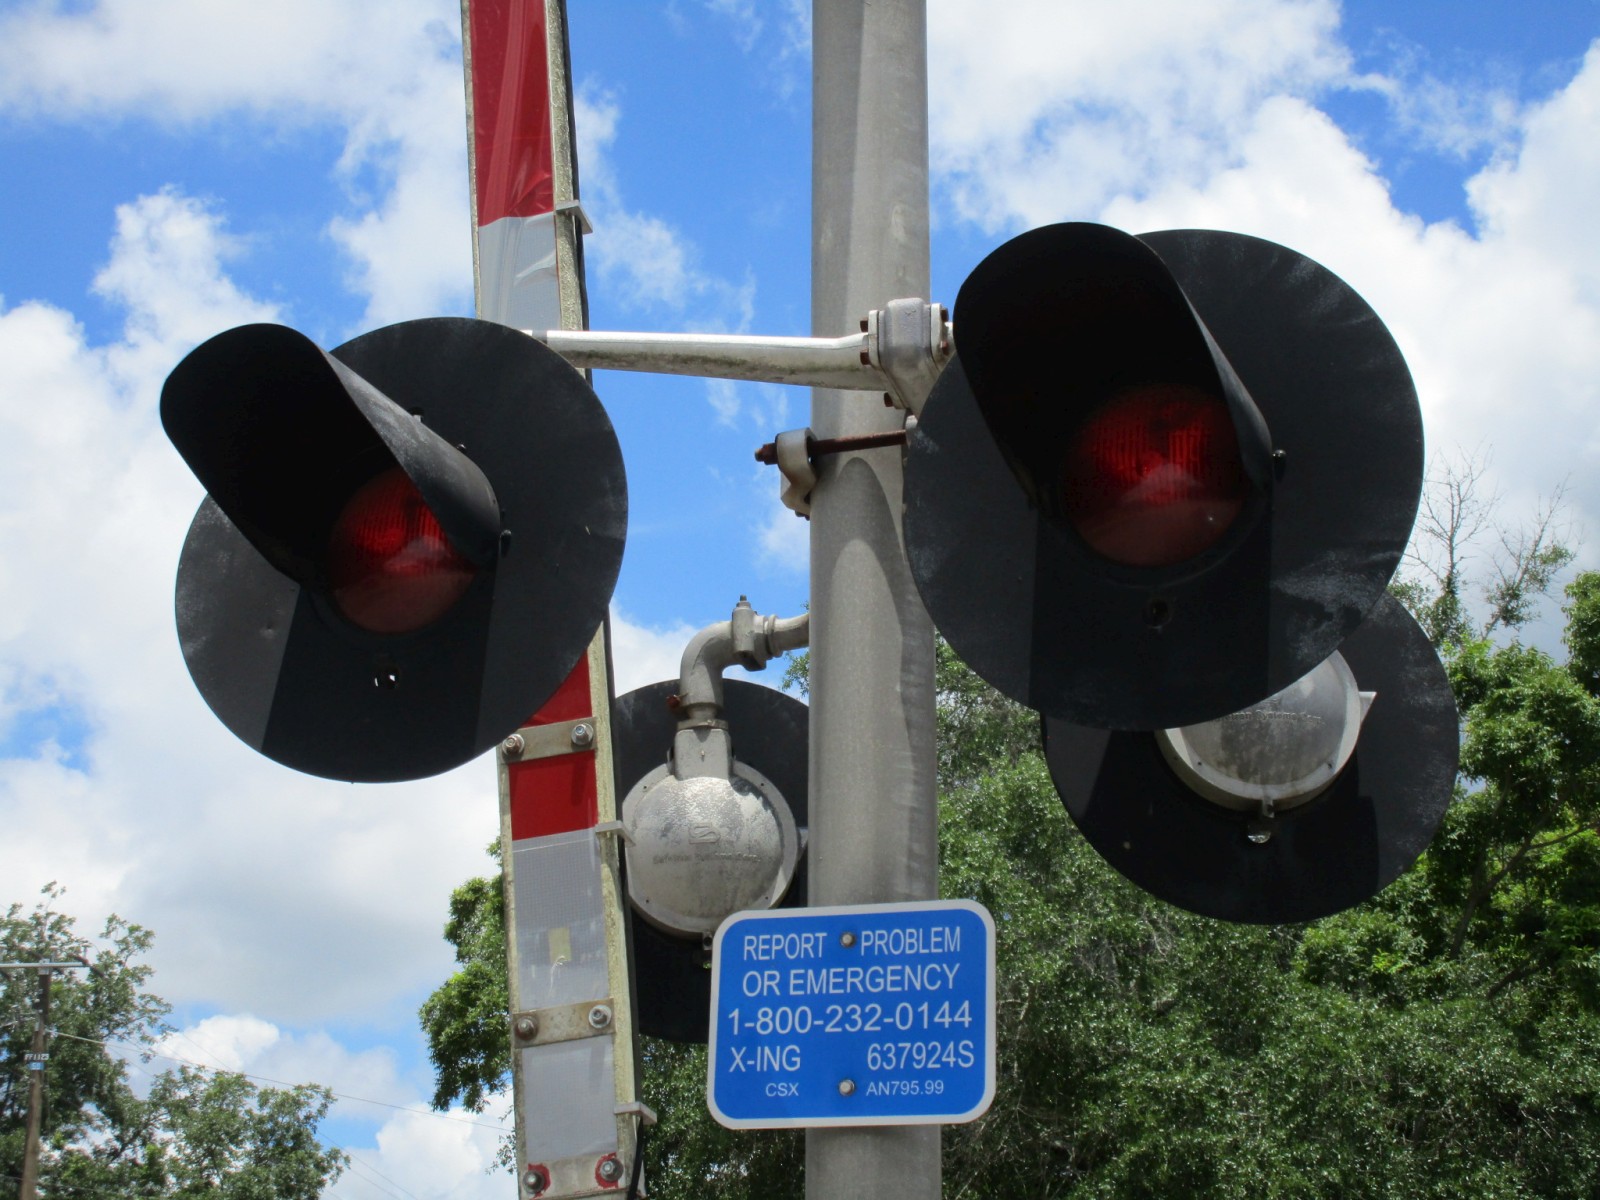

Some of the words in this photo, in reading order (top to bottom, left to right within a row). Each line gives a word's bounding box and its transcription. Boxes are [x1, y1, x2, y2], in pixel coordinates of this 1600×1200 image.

[744, 933, 827, 961] REPORT
[861, 926, 961, 956] PROBLEM
[743, 970, 781, 997] OR
[789, 963, 960, 996] EMERGENCY
[728, 999, 973, 1035] 1-800-232-0144
[729, 1045, 801, 1072] X-ING
[867, 1039, 975, 1071] 637924S
[765, 1082, 799, 1097] CSX
[866, 1079, 944, 1097] AN795.99
